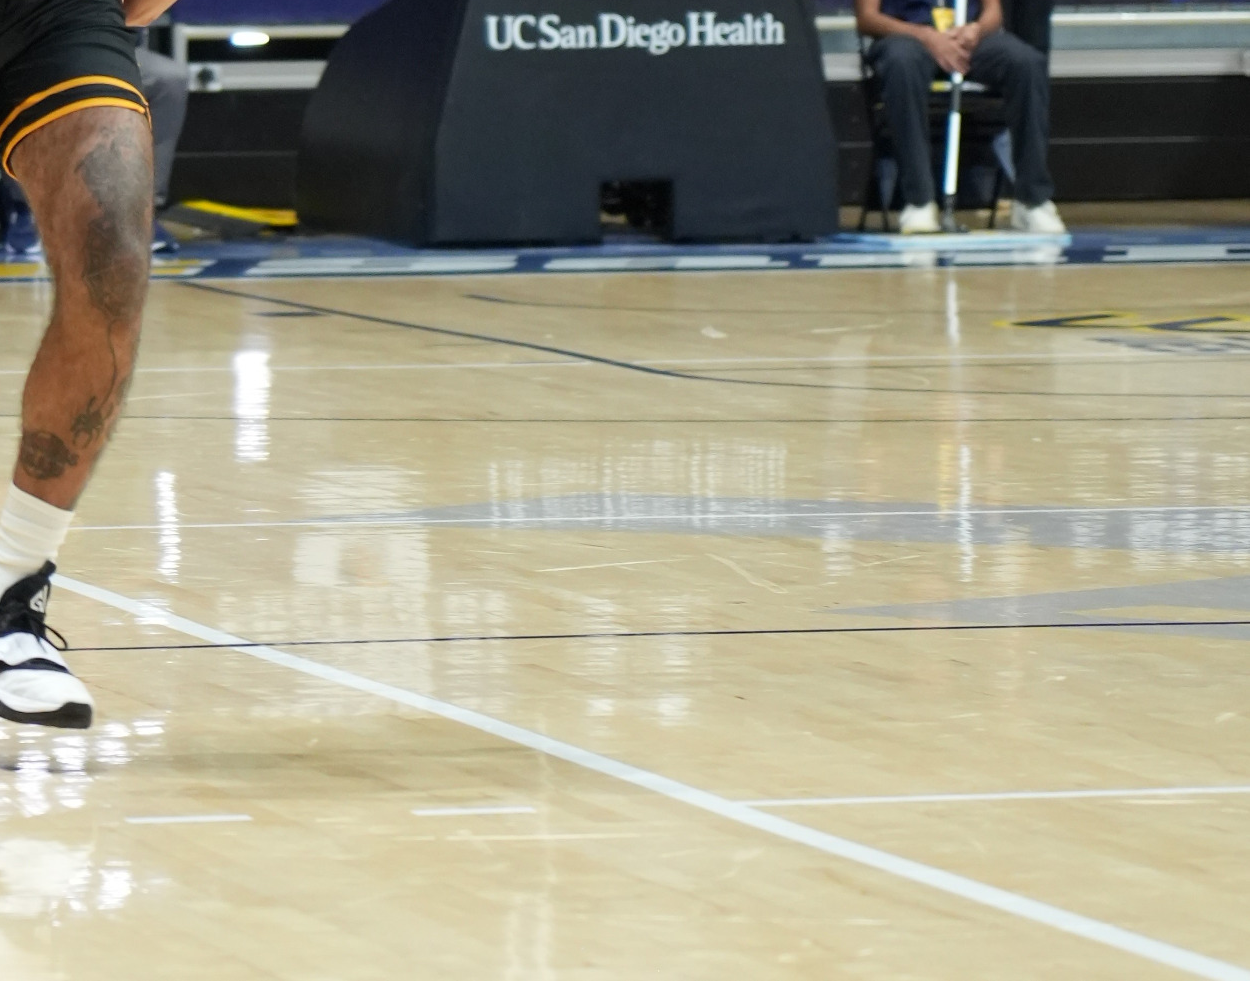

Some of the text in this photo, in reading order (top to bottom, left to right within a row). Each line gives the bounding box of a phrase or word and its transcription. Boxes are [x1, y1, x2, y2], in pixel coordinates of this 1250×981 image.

[485, 10, 786, 56] UC San Diego Health
